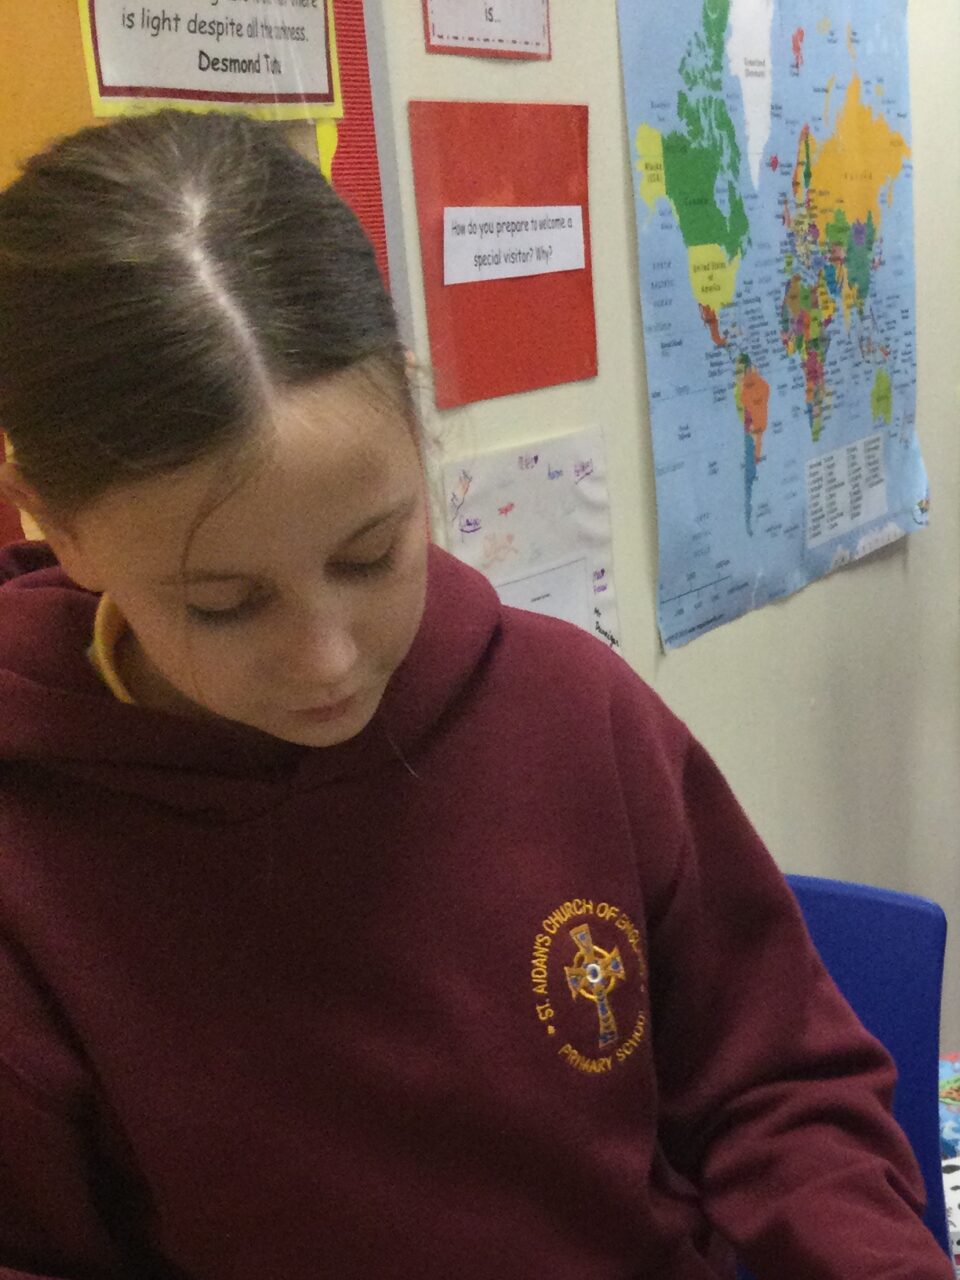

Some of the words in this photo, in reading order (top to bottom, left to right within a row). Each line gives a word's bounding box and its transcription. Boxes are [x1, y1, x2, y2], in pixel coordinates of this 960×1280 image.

[122, 7, 136, 29] is
[141, 9, 181, 37] light
[187, 13, 243, 42] despite
[198, 50, 261, 75] Desmond
[451, 219, 466, 236] How
[468, 218, 477, 235] do
[479, 220, 494, 239] you
[496, 219, 529, 238] prepare
[473, 249, 502, 272] special
[542, 898, 594, 935] CHURCH
[596, 902, 620, 921] OF
[558, 1043, 614, 1073] PRIMARY
